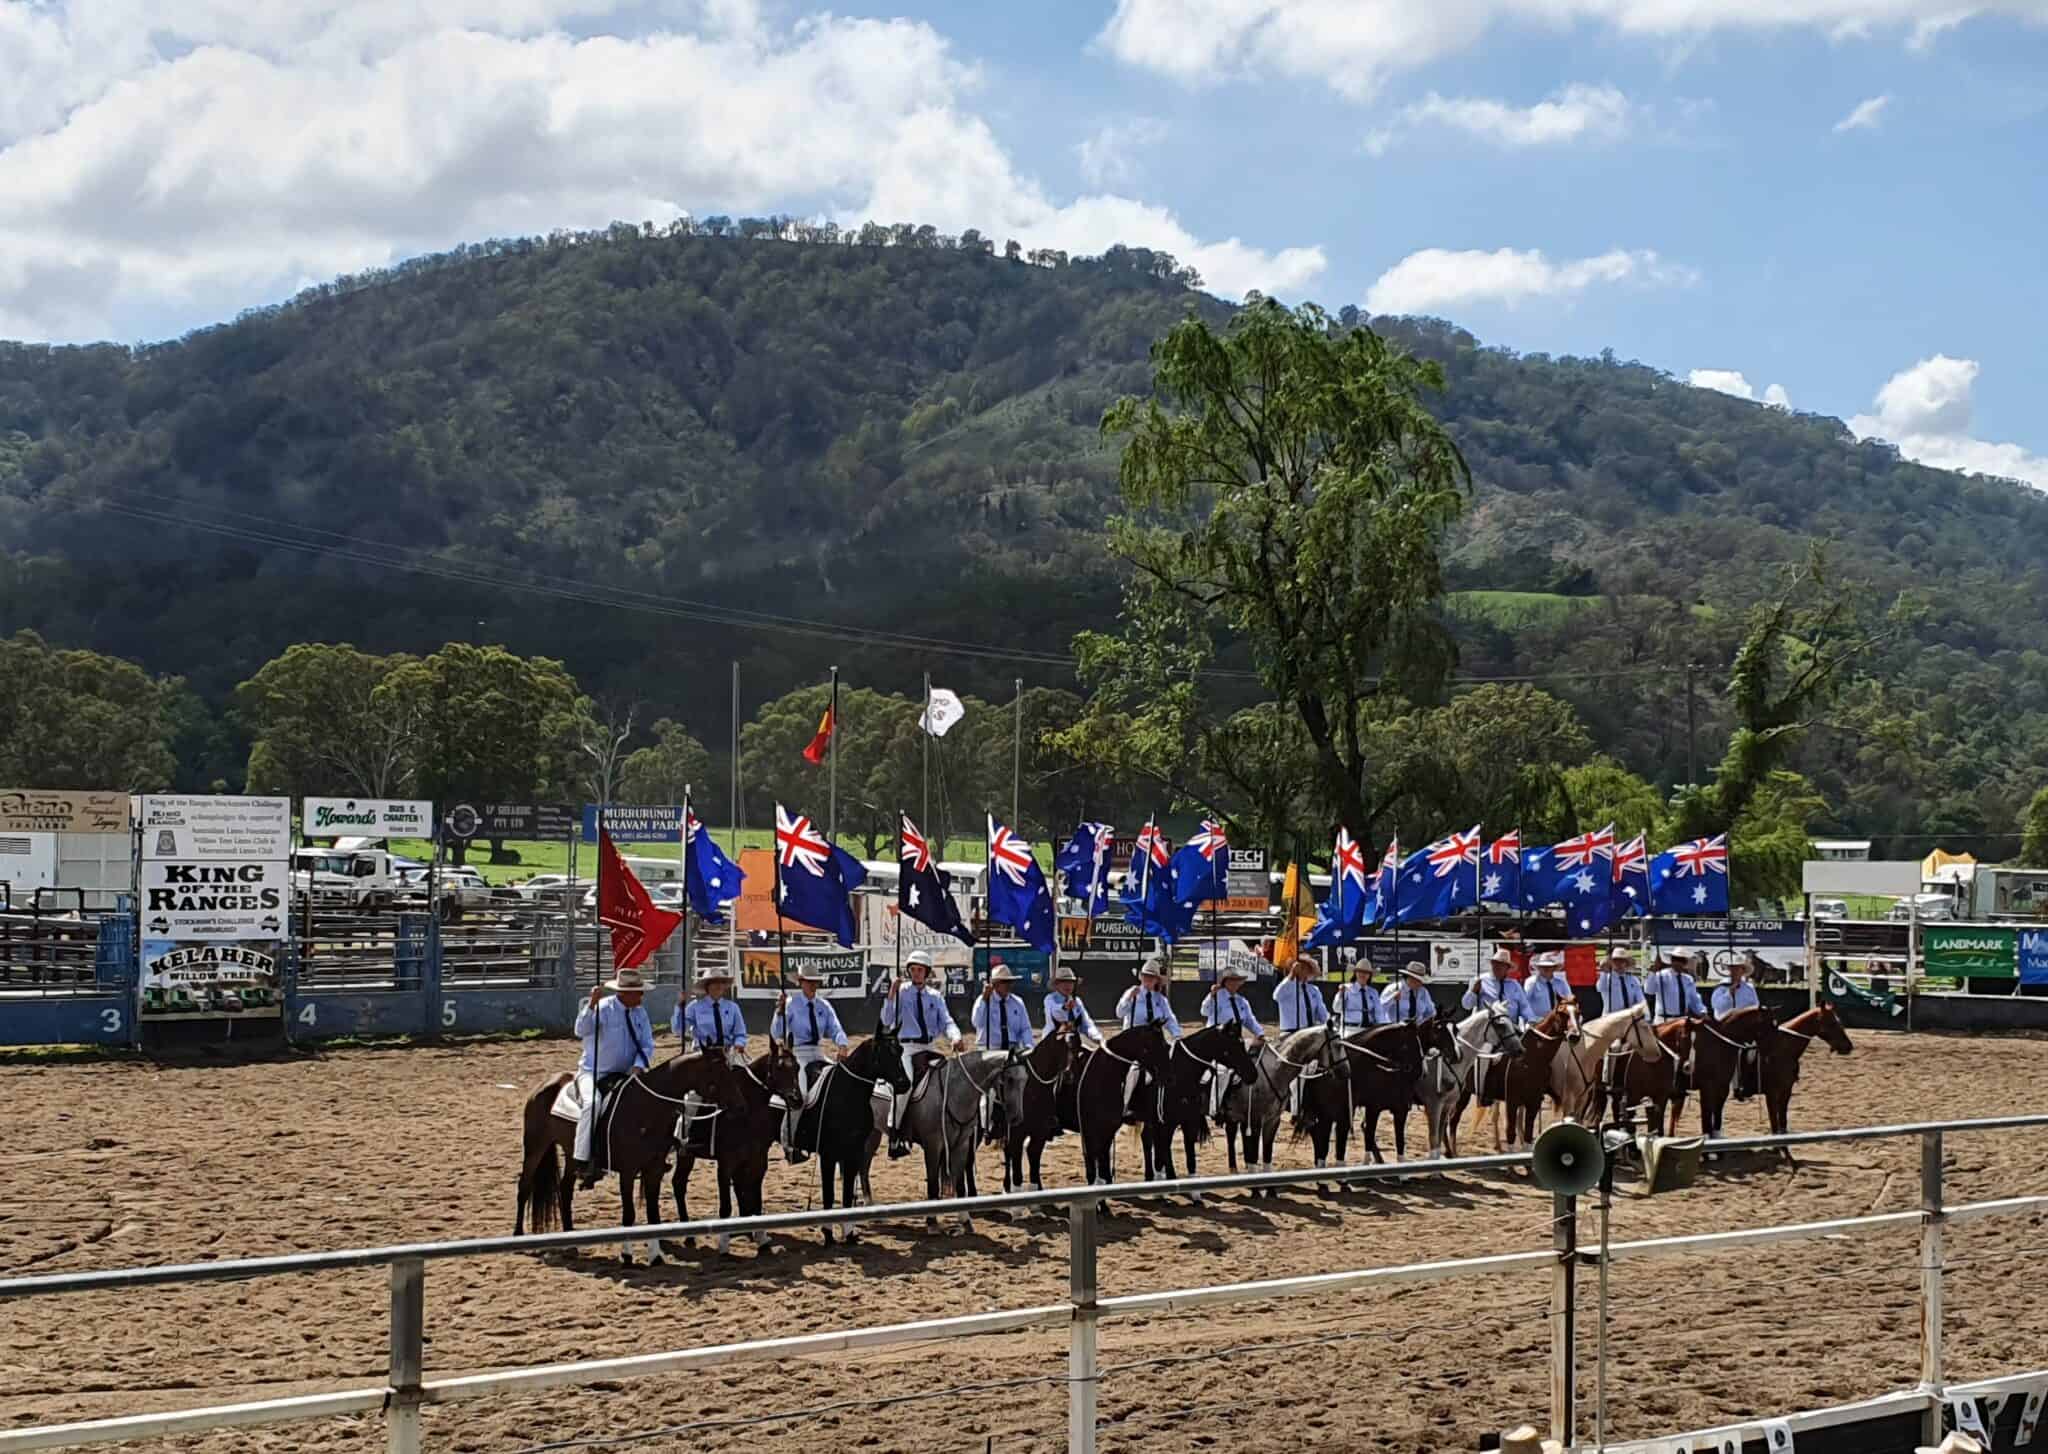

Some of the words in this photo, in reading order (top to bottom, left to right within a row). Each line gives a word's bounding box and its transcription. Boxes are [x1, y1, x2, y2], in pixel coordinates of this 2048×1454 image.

[315, 805, 376, 827] Howard's
[603, 807, 676, 819] MURRURUNDI
[596, 819, 648, 831] ARAVAN
[164, 864, 265, 883] KING
[148, 887, 280, 911] RANGES
[178, 885, 205, 894] OF
[209, 885, 252, 893] THE
[1736, 921, 1783, 931] STATION
[1104, 940, 1140, 951] RURA
[1933, 938, 2003, 950] LANDMARK
[149, 945, 275, 977] KELAHER
[100, 1007, 122, 1033] 3
[298, 1002, 317, 1026] 4
[441, 999, 457, 1027] 5
